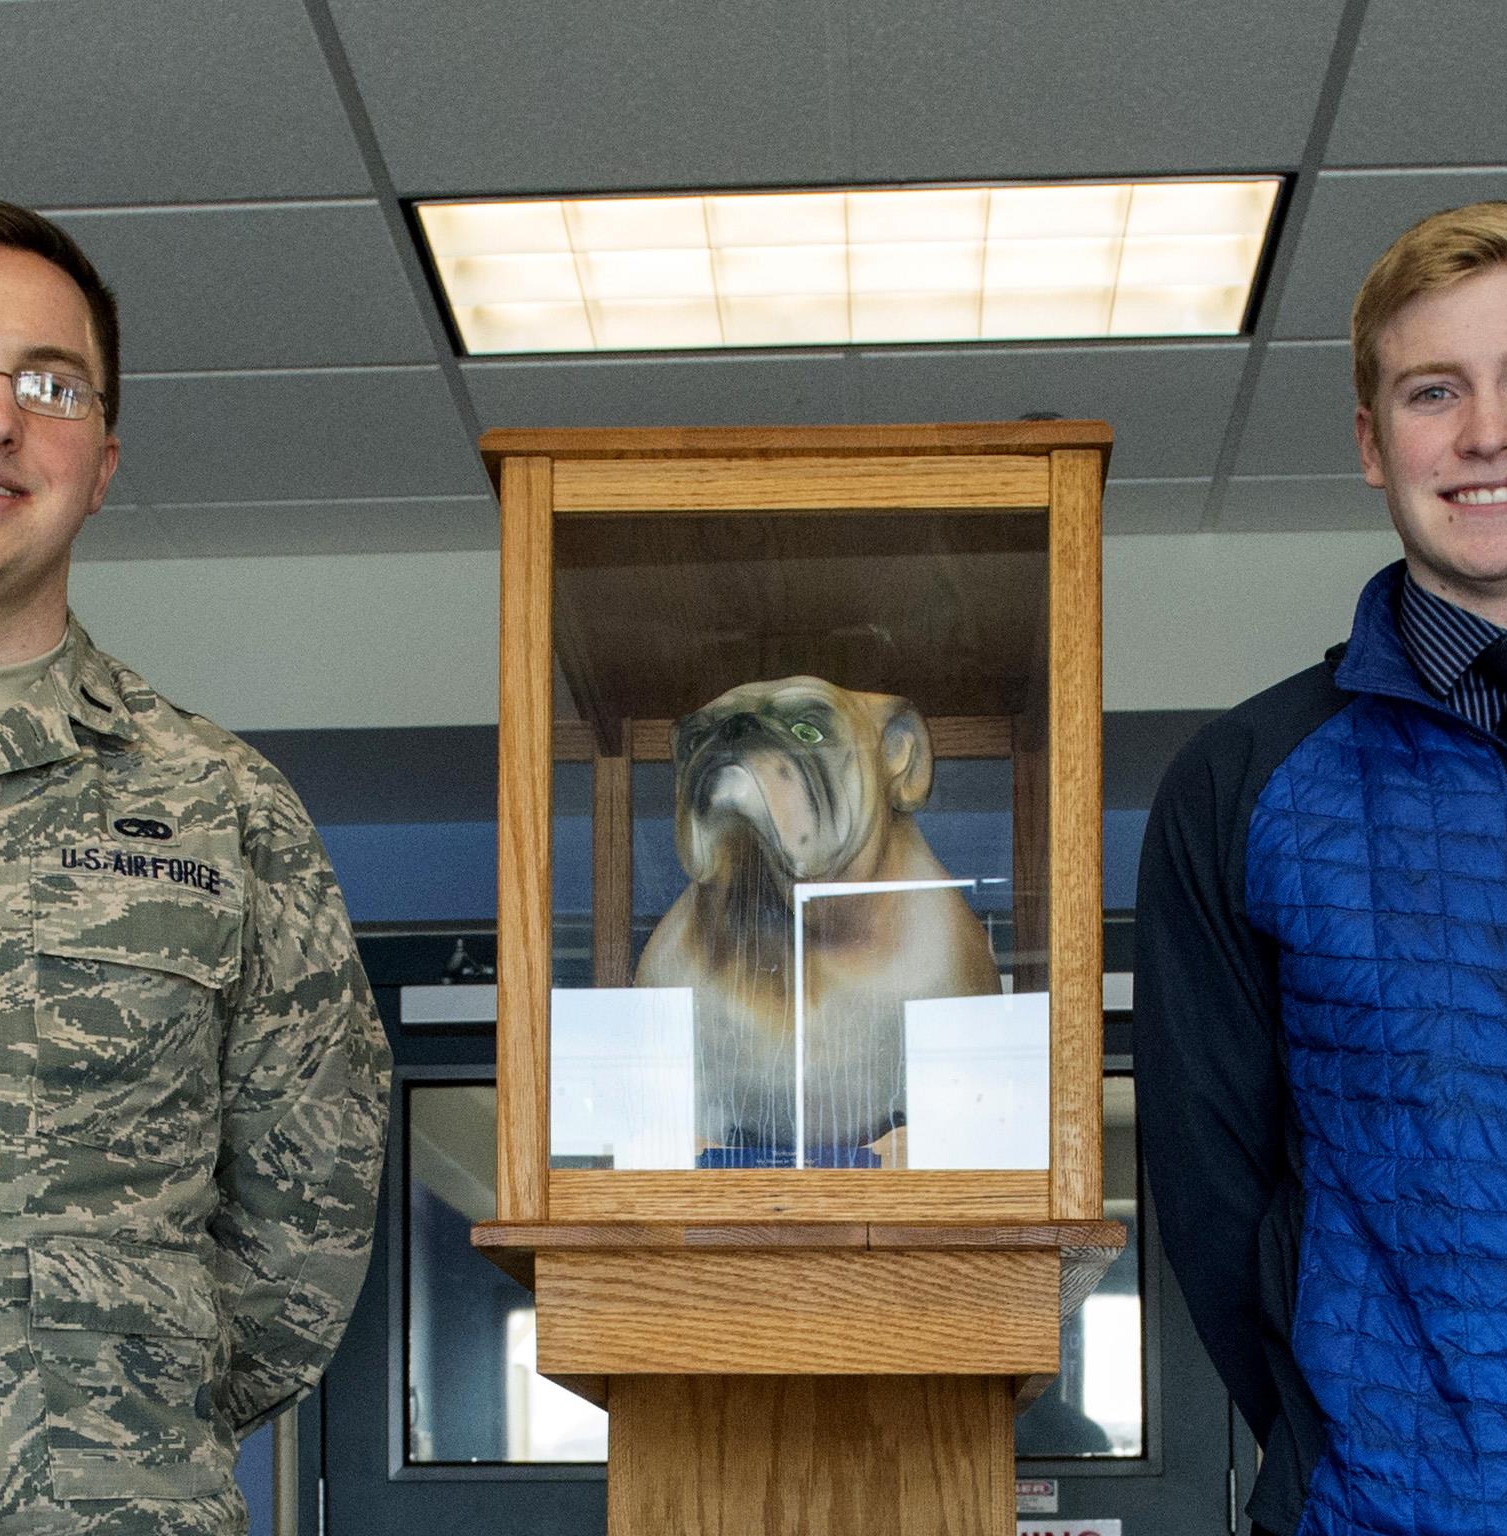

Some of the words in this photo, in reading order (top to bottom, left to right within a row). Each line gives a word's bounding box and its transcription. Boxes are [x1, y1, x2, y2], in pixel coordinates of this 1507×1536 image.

[61, 848, 108, 871] U.S.
[113, 853, 148, 878] AIR
[151, 857, 221, 896] FORCE
